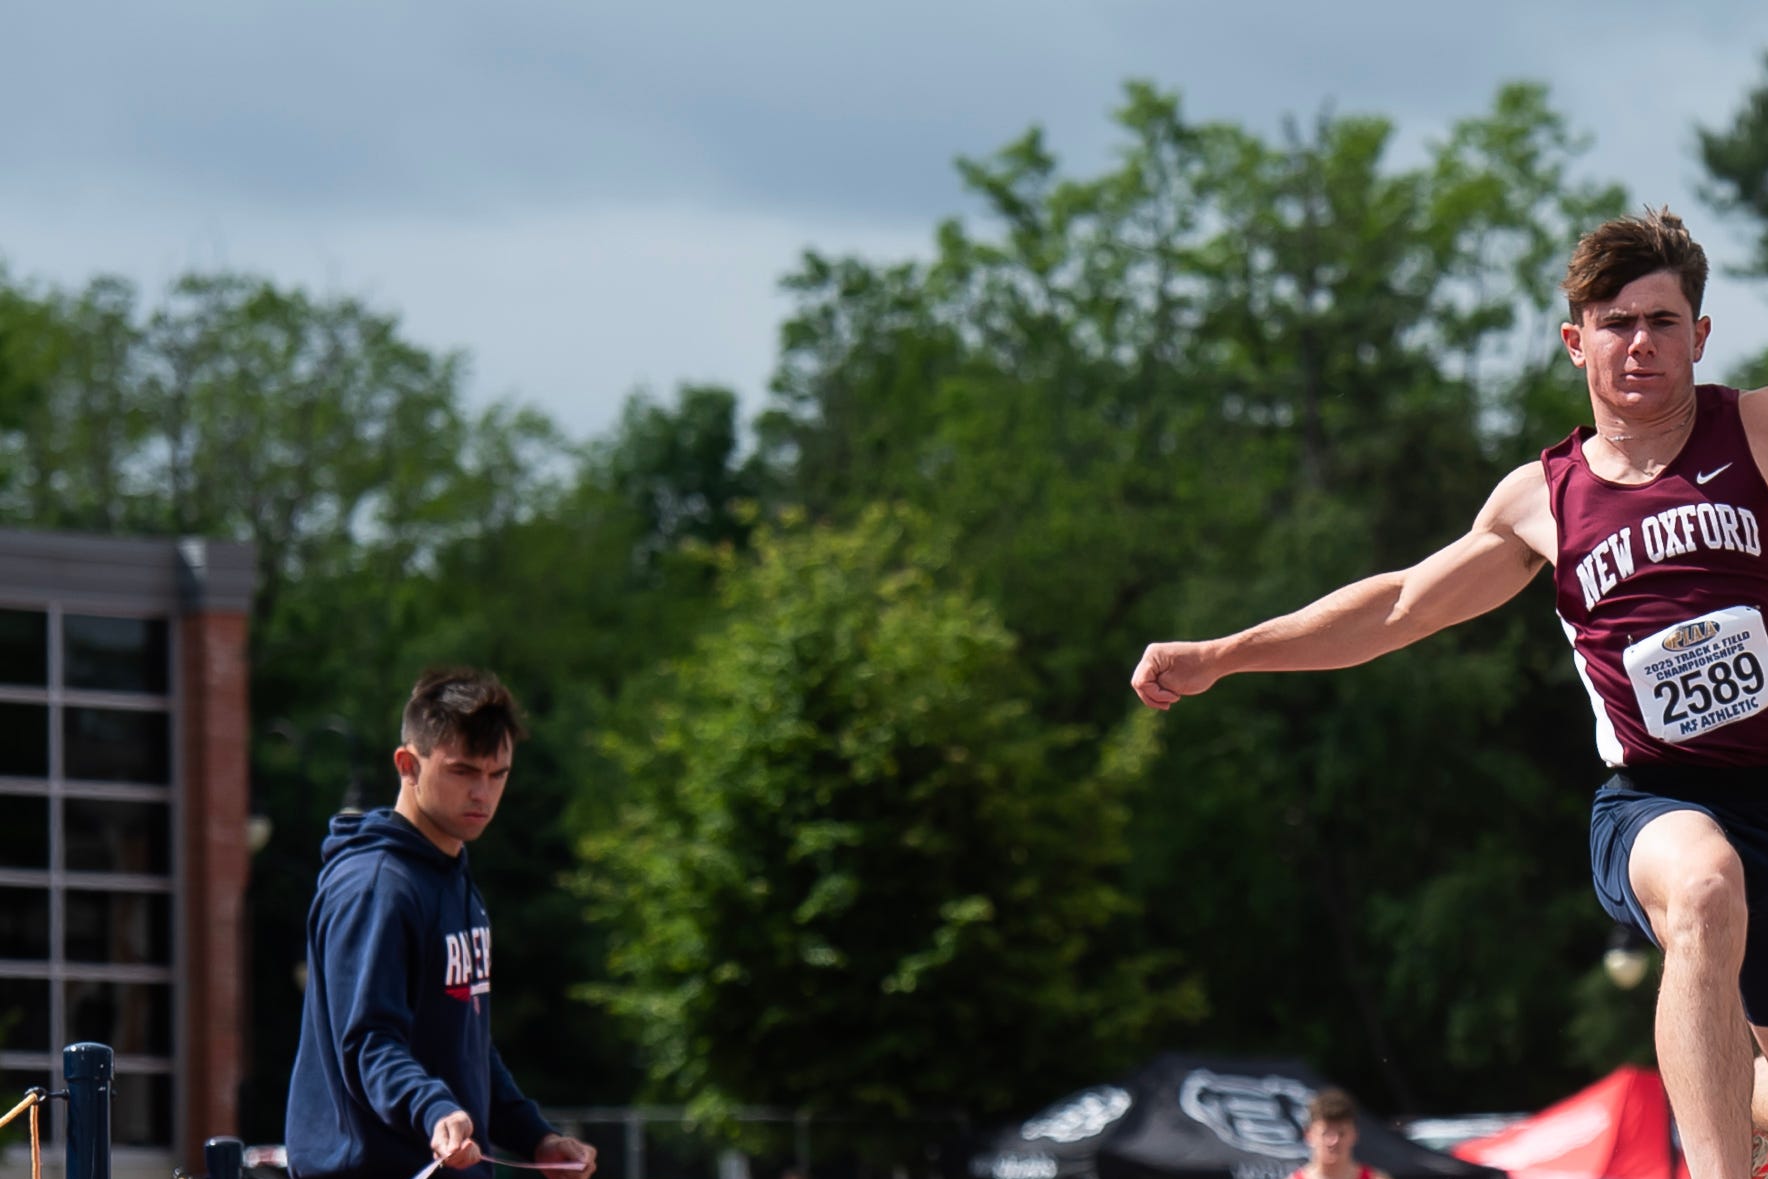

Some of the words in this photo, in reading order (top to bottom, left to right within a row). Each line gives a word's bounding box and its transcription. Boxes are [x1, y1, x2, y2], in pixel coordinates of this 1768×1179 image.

[1576, 527, 1636, 612] NEW
[1641, 502, 1761, 564] OXFORD
[1644, 660, 1673, 675] 2025
[1675, 645, 1711, 664] TRACK
[1722, 631, 1750, 647] FIELD
[1664, 621, 1719, 650] PIAA
[1656, 643, 1745, 681] CHAMPIONSHIPS
[1653, 652, 1764, 725] 2589
[1701, 696, 1759, 729] ATHLETIC
